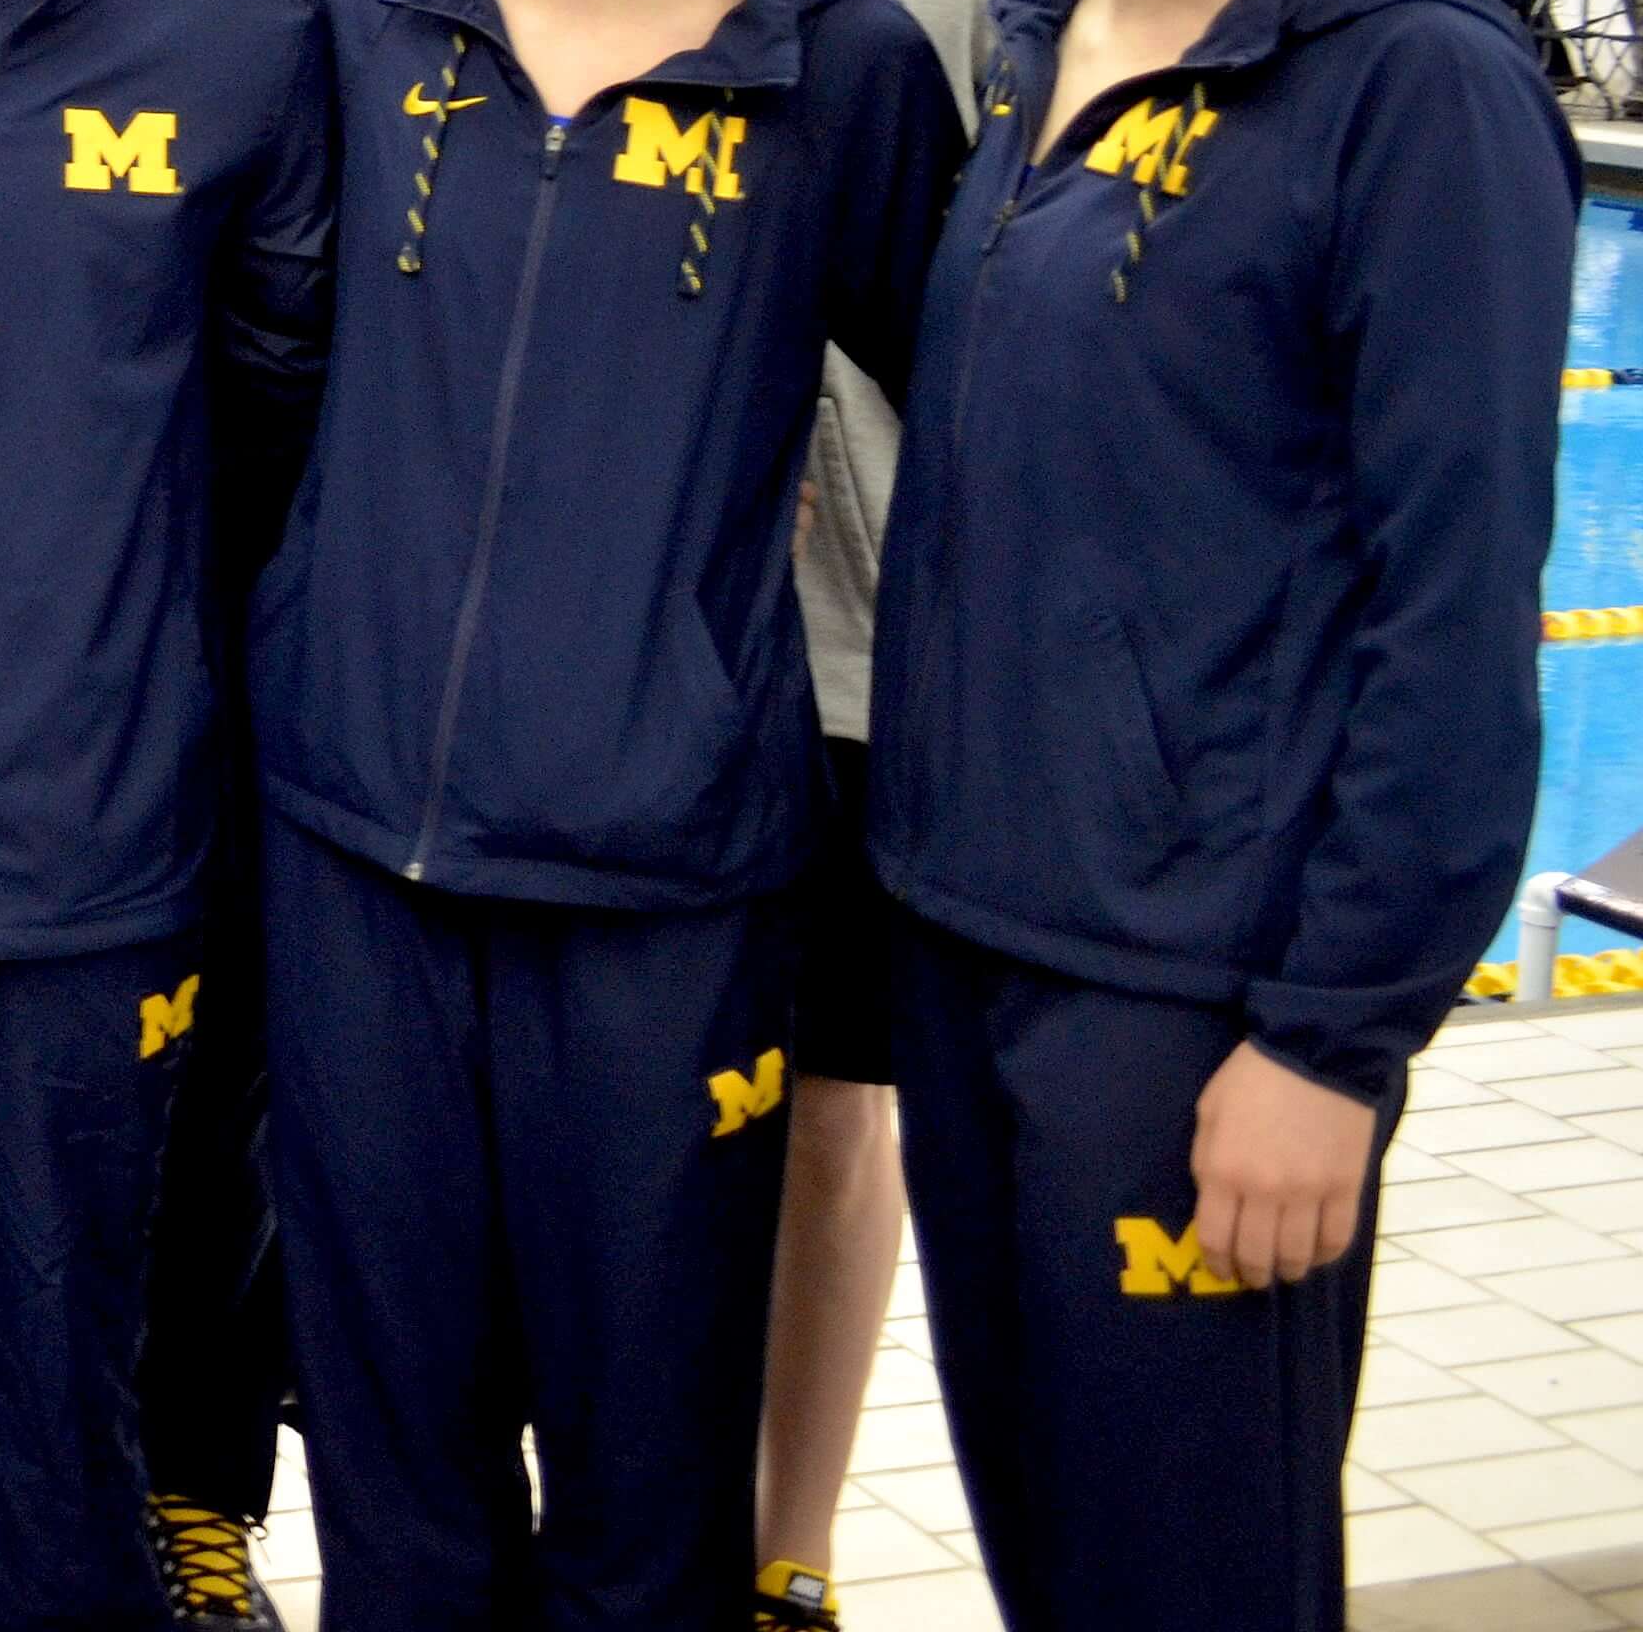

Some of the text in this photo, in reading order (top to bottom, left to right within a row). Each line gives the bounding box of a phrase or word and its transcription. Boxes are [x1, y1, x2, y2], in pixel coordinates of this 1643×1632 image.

[63, 108, 185, 194] M
[613, 95, 745, 201] M
[1084, 98, 1219, 197] M
